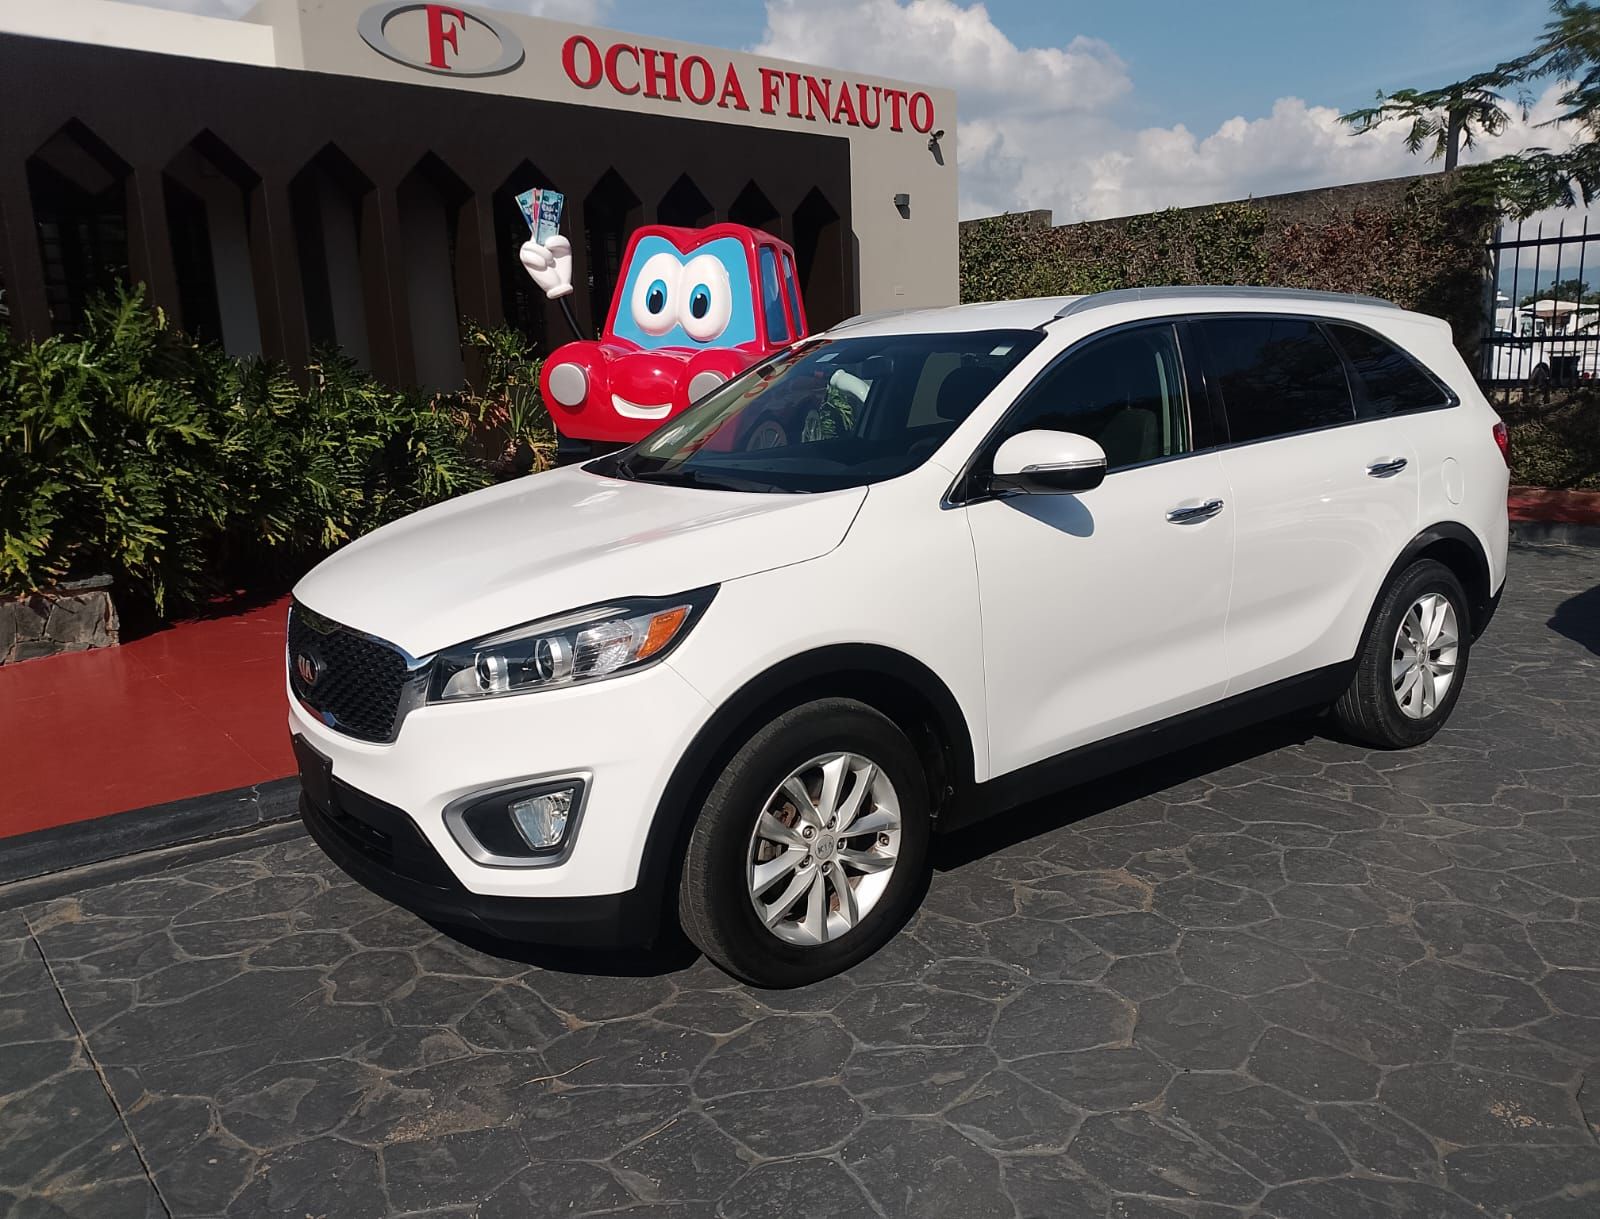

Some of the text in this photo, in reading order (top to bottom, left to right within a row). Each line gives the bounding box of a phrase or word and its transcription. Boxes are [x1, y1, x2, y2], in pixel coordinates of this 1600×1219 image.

[426, 4, 465, 69] F
[561, 34, 935, 133] OCHOA FINAUTO
